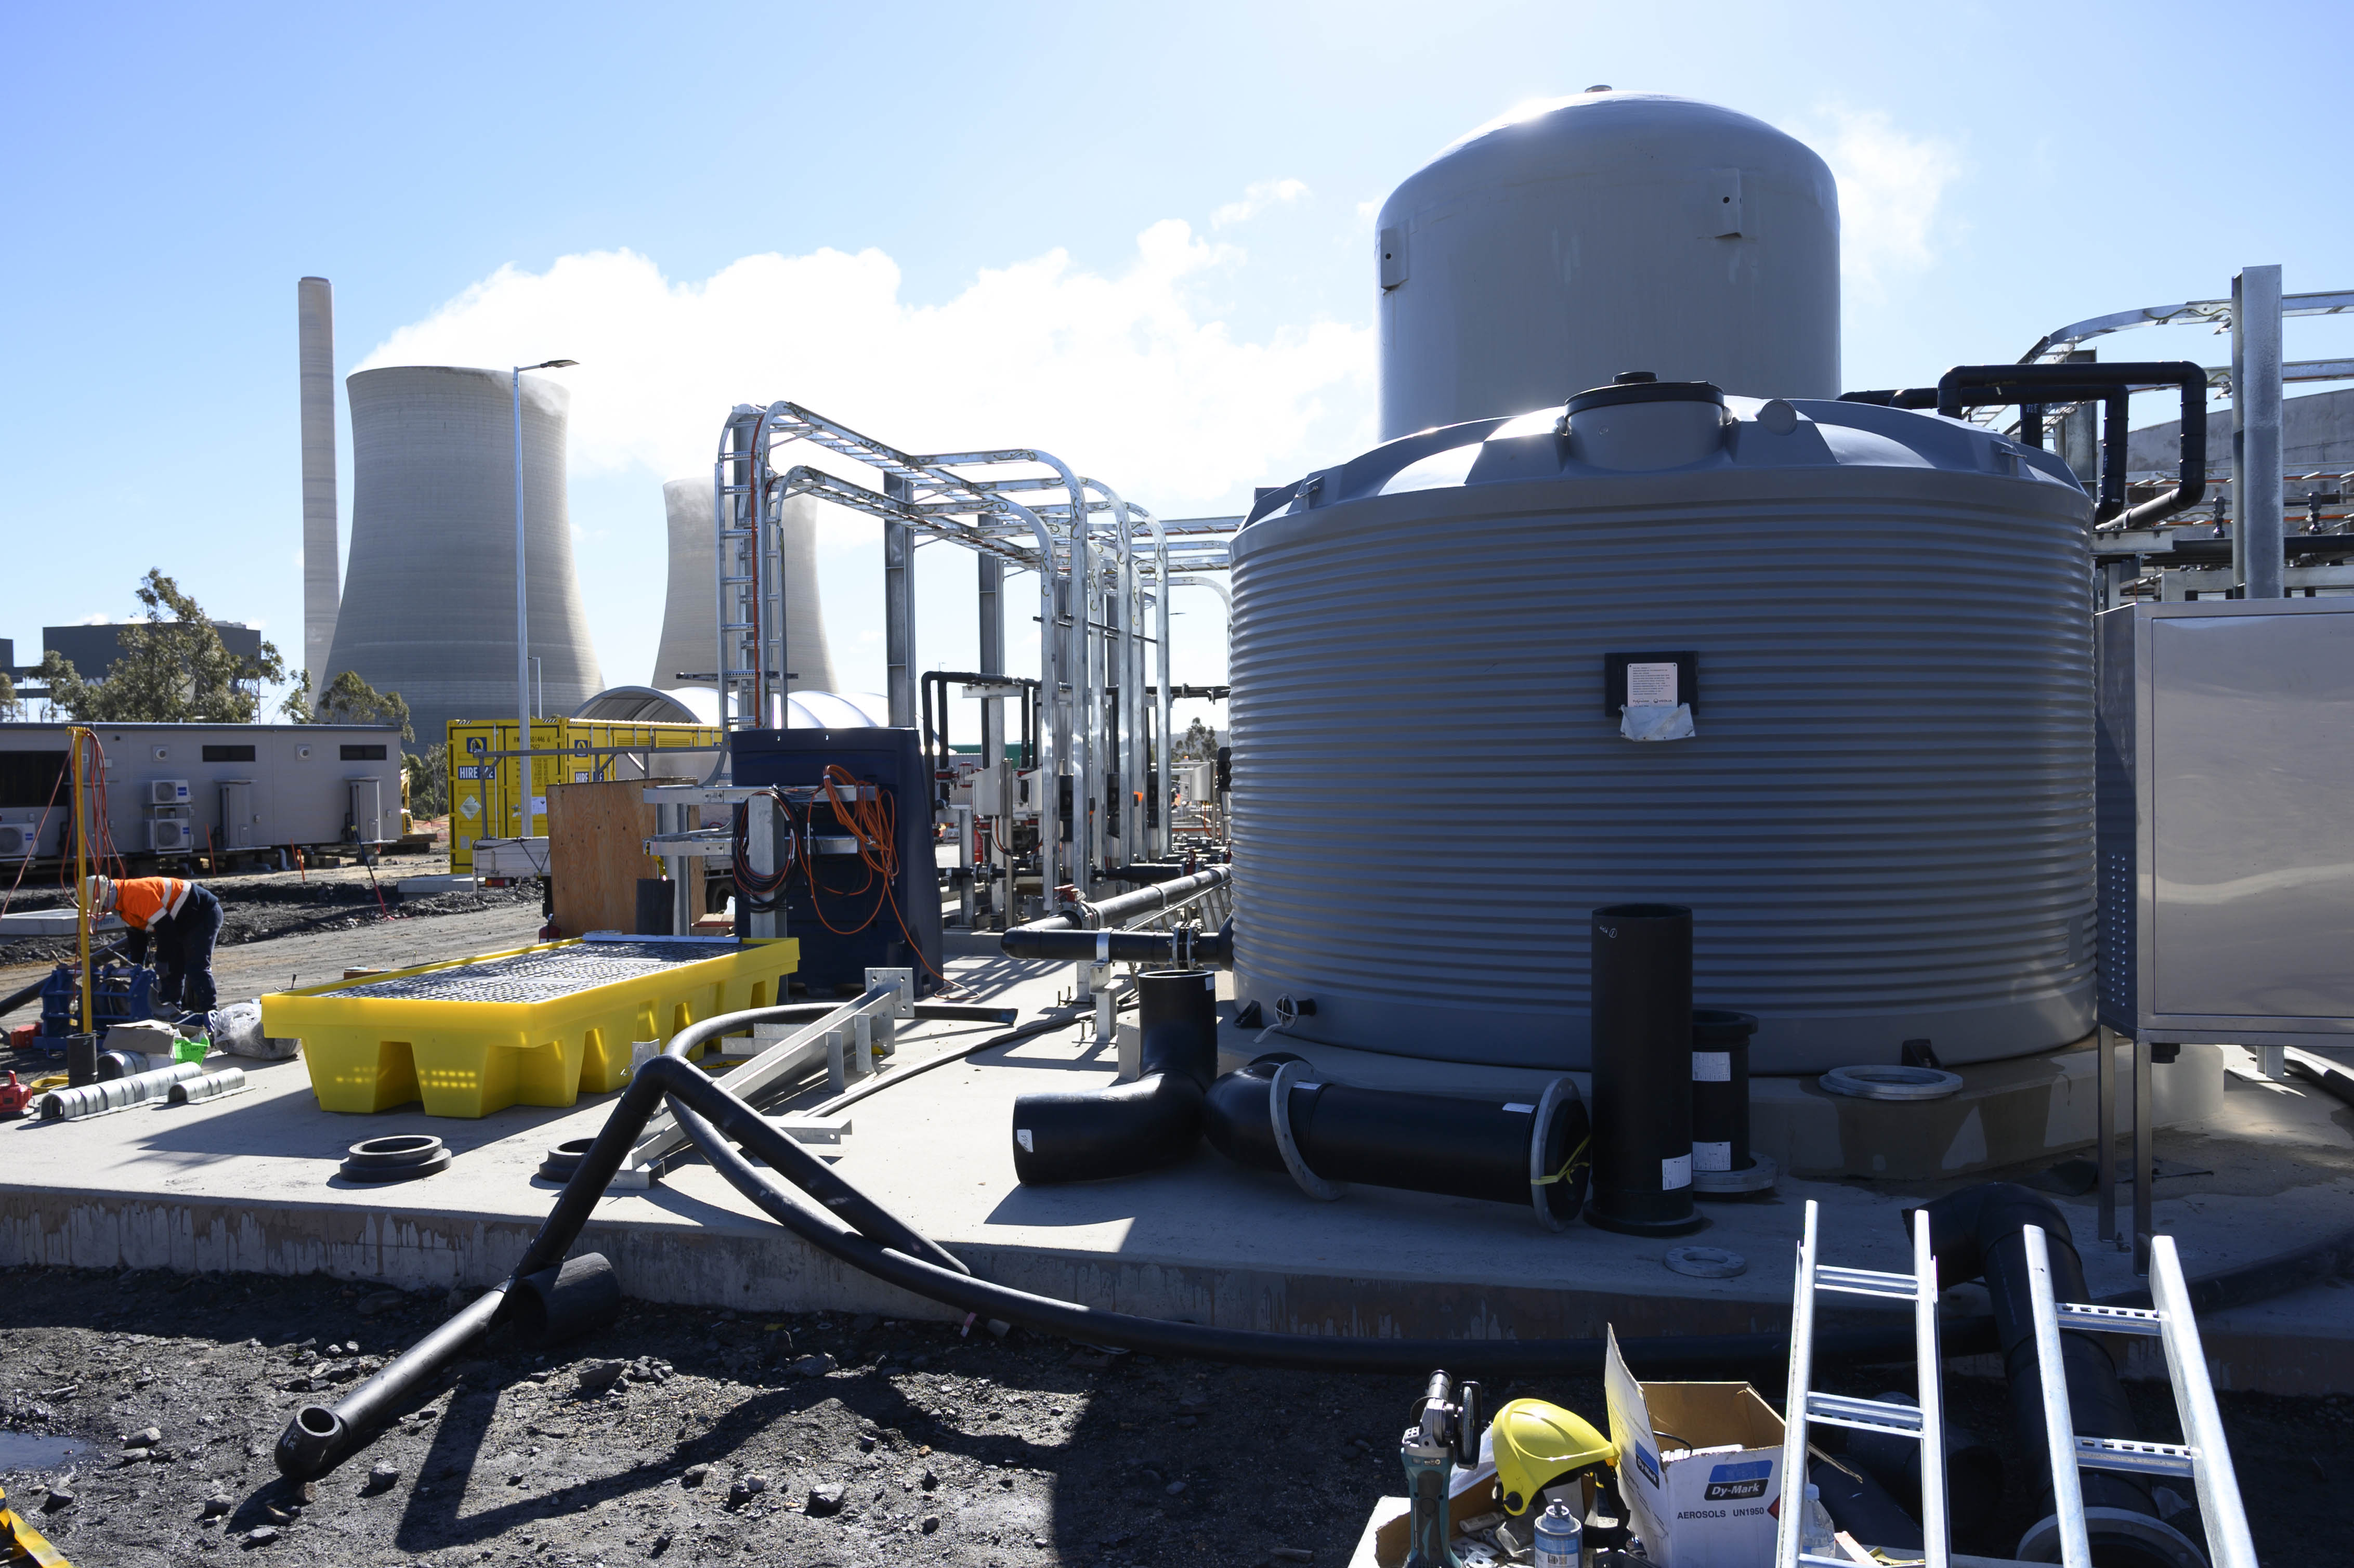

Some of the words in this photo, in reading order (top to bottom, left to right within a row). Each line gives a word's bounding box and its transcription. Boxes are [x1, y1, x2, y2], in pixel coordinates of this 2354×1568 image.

[460, 767, 478, 778] HIRE
[1638, 1458, 1657, 1483] Dy-Mark
[1711, 1483, 1760, 1497] Dy-Mark
[1677, 1509, 1727, 1520] AEROSOLS
[1733, 1507, 1764, 1517] UN1950
